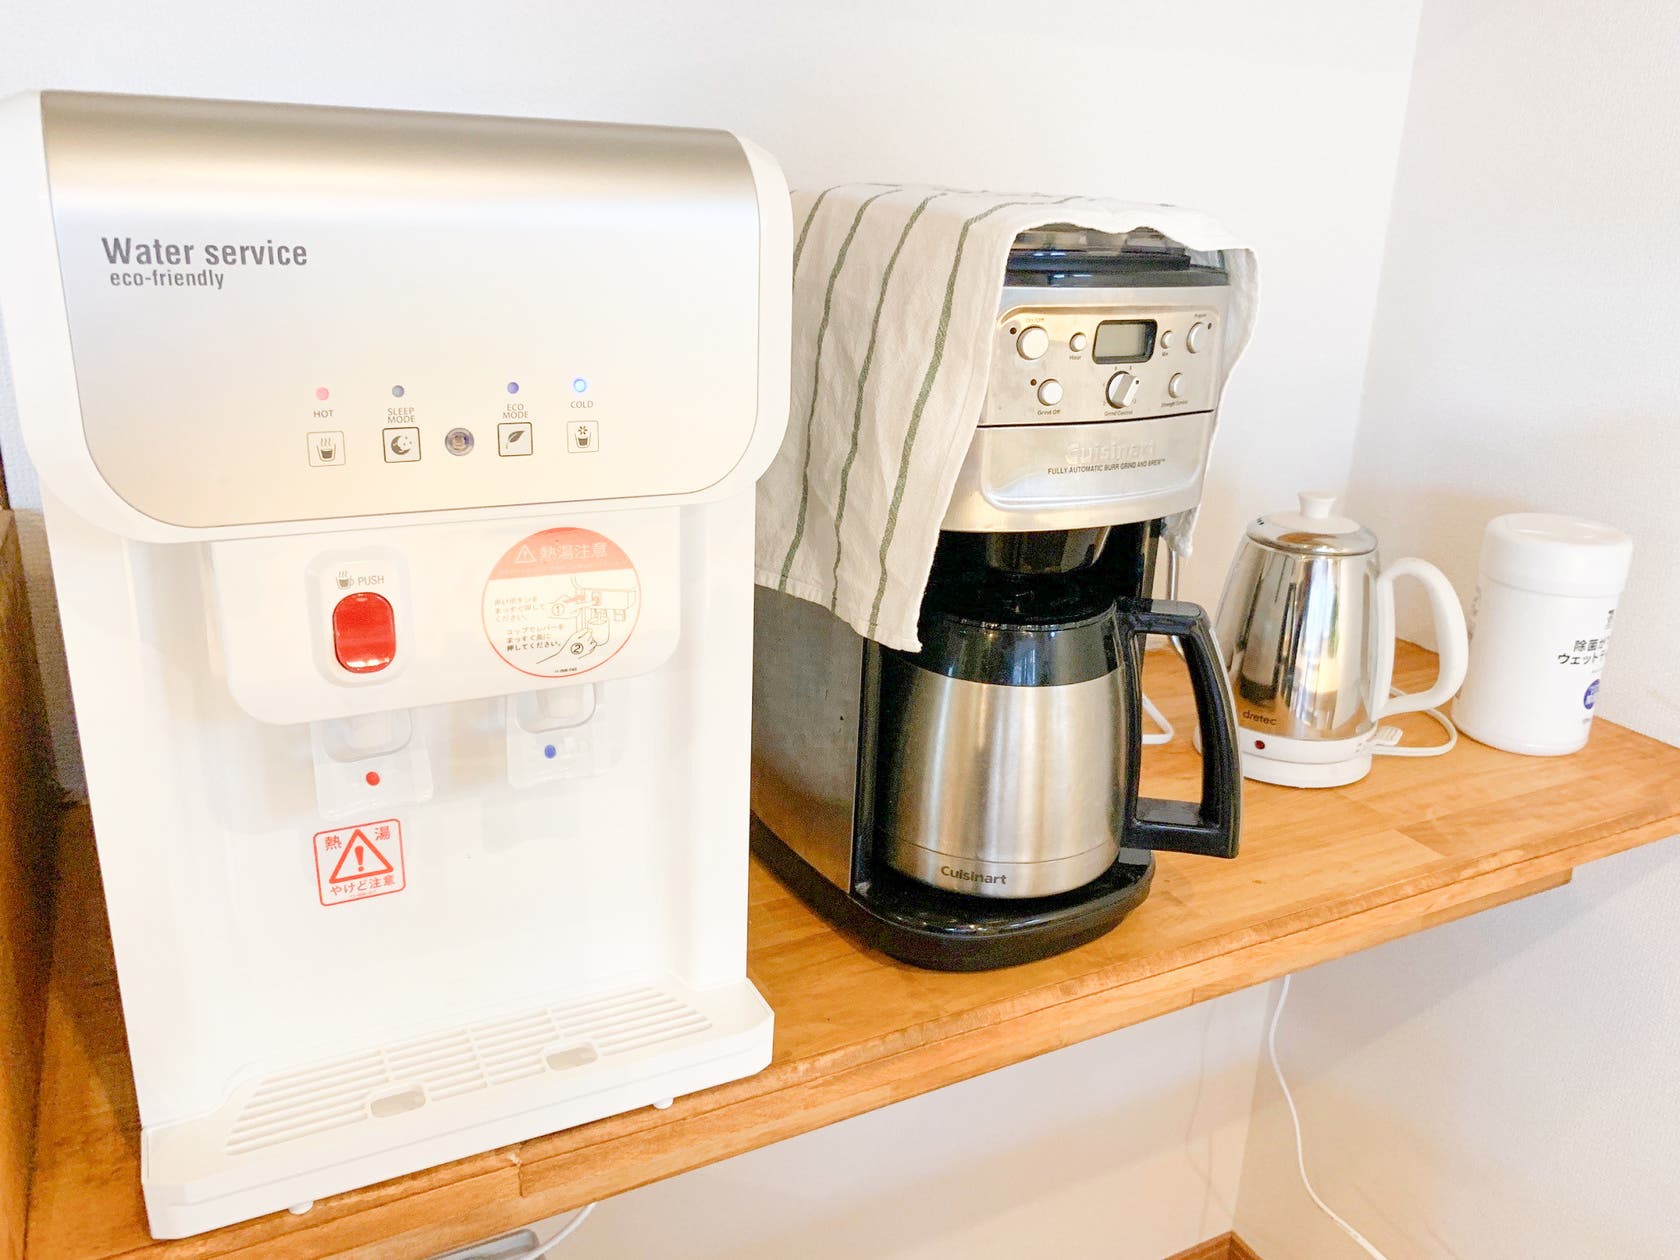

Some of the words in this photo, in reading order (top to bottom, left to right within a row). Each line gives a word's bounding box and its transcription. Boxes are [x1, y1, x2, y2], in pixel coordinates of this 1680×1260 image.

[101, 237, 194, 265] Water
[204, 240, 308, 265] service
[110, 269, 224, 290] eco-friendly
[507, 403, 524, 411] ECO
[570, 400, 594, 408] COLD
[313, 410, 334, 418] HOT
[387, 407, 415, 415] SLEEP
[502, 411, 529, 419] MODE
[387, 415, 415, 424] MODE
[1065, 440, 1155, 465] Cuisinart
[1069, 465, 1103, 473] AUTOMATIC
[1120, 462, 1136, 470] GRIND
[358, 575, 384, 586] PUSH
[1242, 710, 1277, 725] dretec
[940, 866, 1007, 884] Cuisinart
[330, 875, 396, 896] やけど注意
